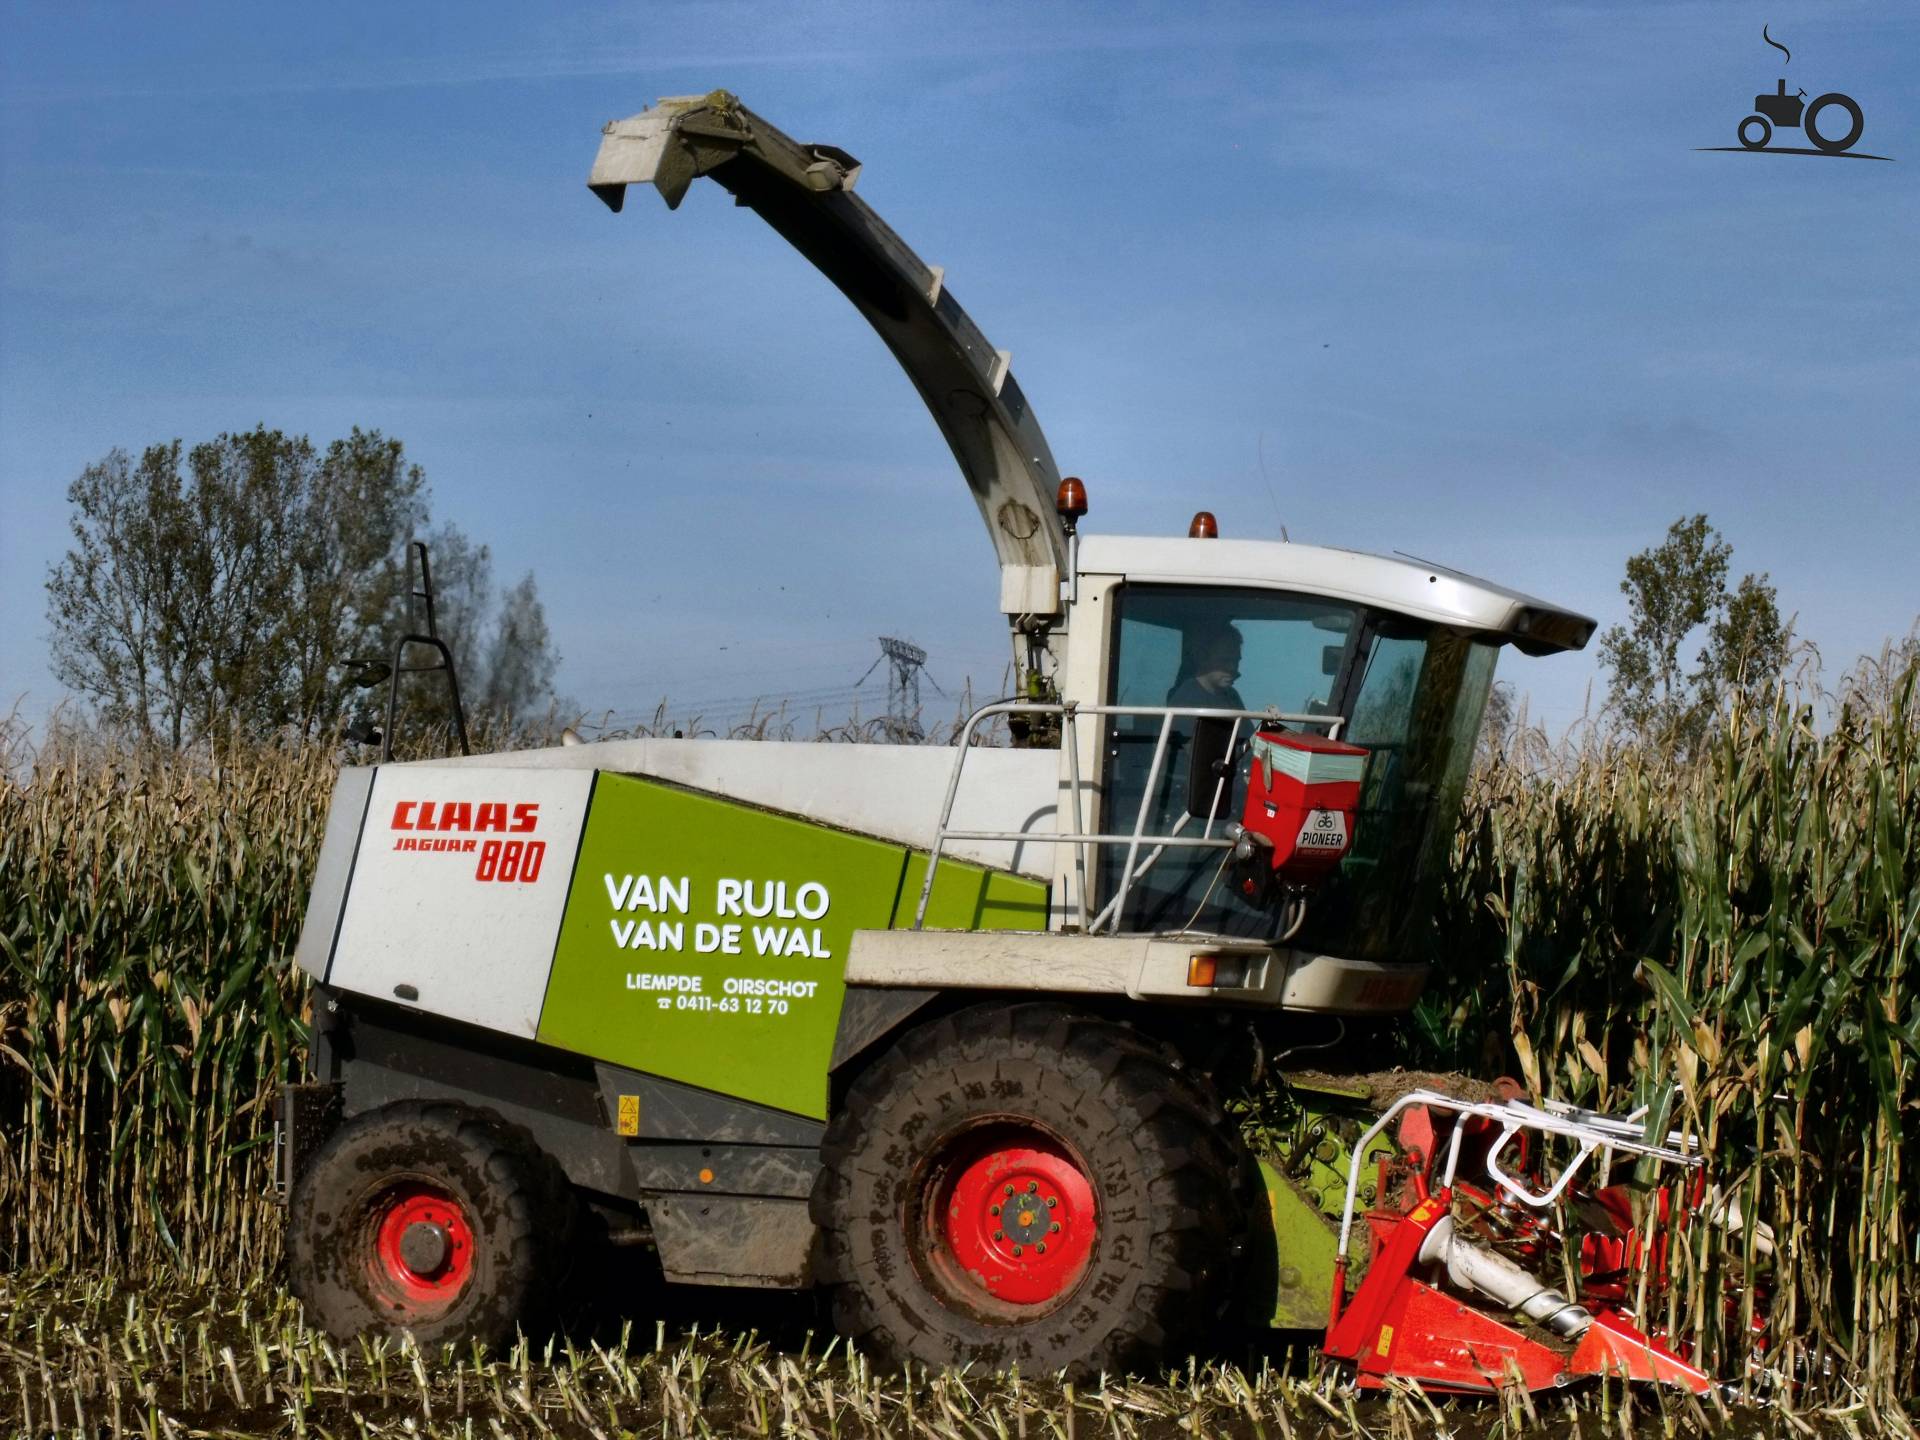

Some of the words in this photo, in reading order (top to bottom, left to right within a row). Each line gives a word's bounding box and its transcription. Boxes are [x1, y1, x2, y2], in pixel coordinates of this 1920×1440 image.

[391, 800, 540, 833] CLAAS
[1302, 832, 1343, 846] PIONEER
[392, 838, 477, 852] JAGUAR
[475, 839, 547, 884] 880
[603, 873, 690, 914] VAN
[716, 878, 831, 920] RULO
[609, 919, 684, 952] VAN
[694, 922, 742, 954] DE
[751, 925, 831, 959] WAL
[626, 973, 702, 993] LIEMPDE
[722, 977, 818, 998] OIRSCHOT
[676, 995, 740, 1013] 0411-63
[744, 998, 763, 1014] 12
[767, 999, 789, 1015] 70
